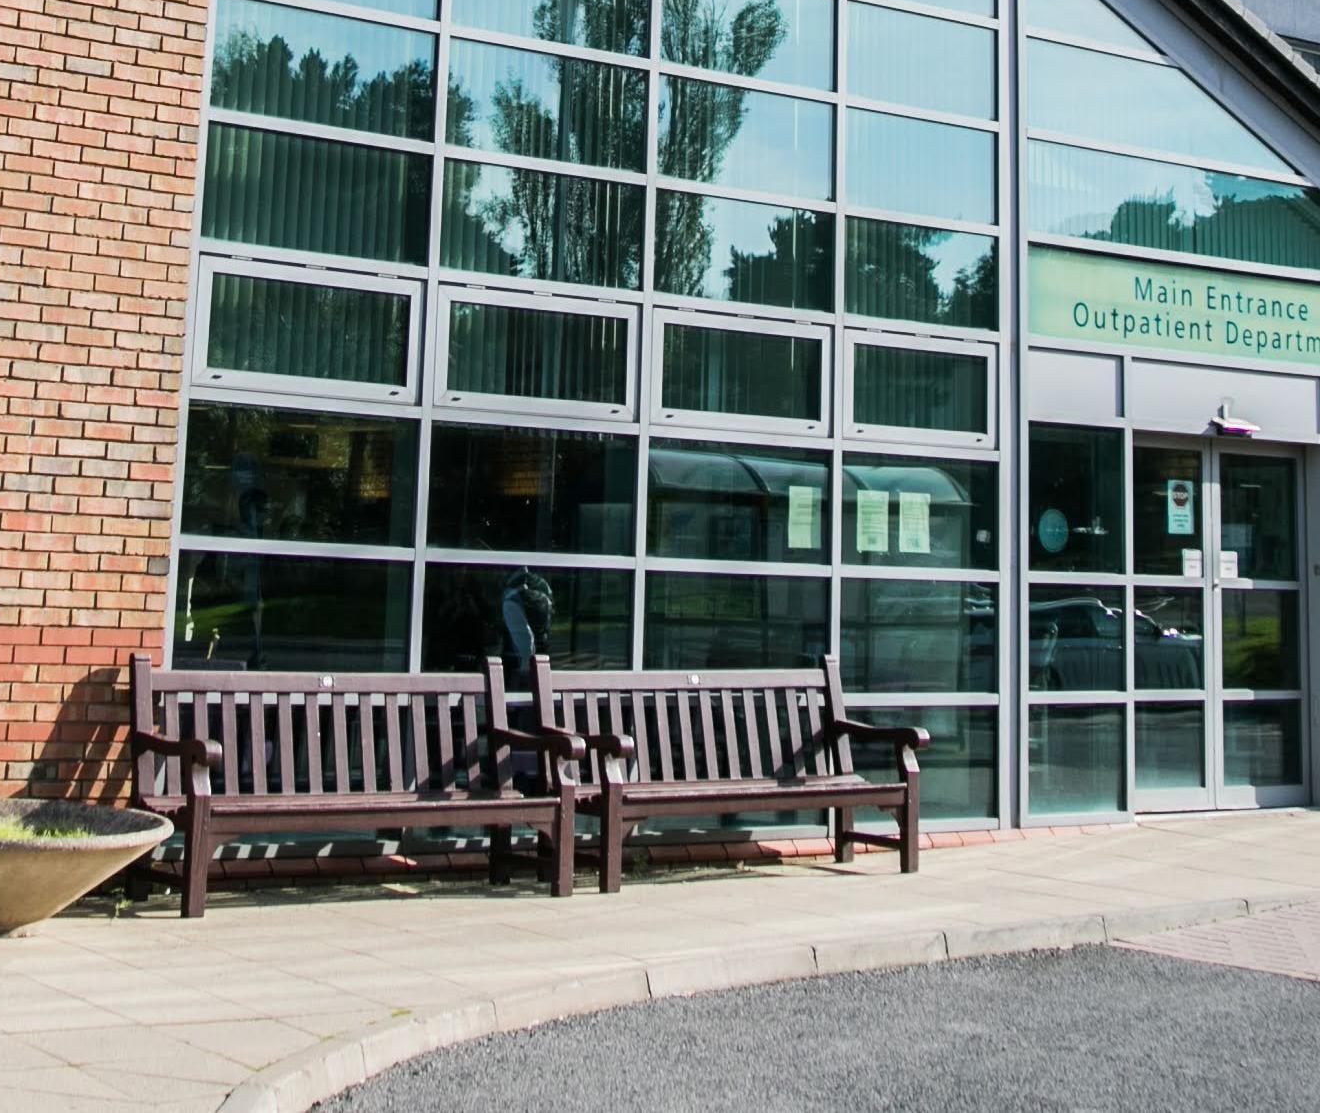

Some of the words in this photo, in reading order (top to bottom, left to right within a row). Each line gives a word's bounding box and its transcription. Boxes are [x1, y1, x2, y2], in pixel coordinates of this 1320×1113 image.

[1134, 276, 1193, 307] Main
[1206, 285, 1309, 322] Entrance
[1073, 301, 1213, 342] Outpatient
